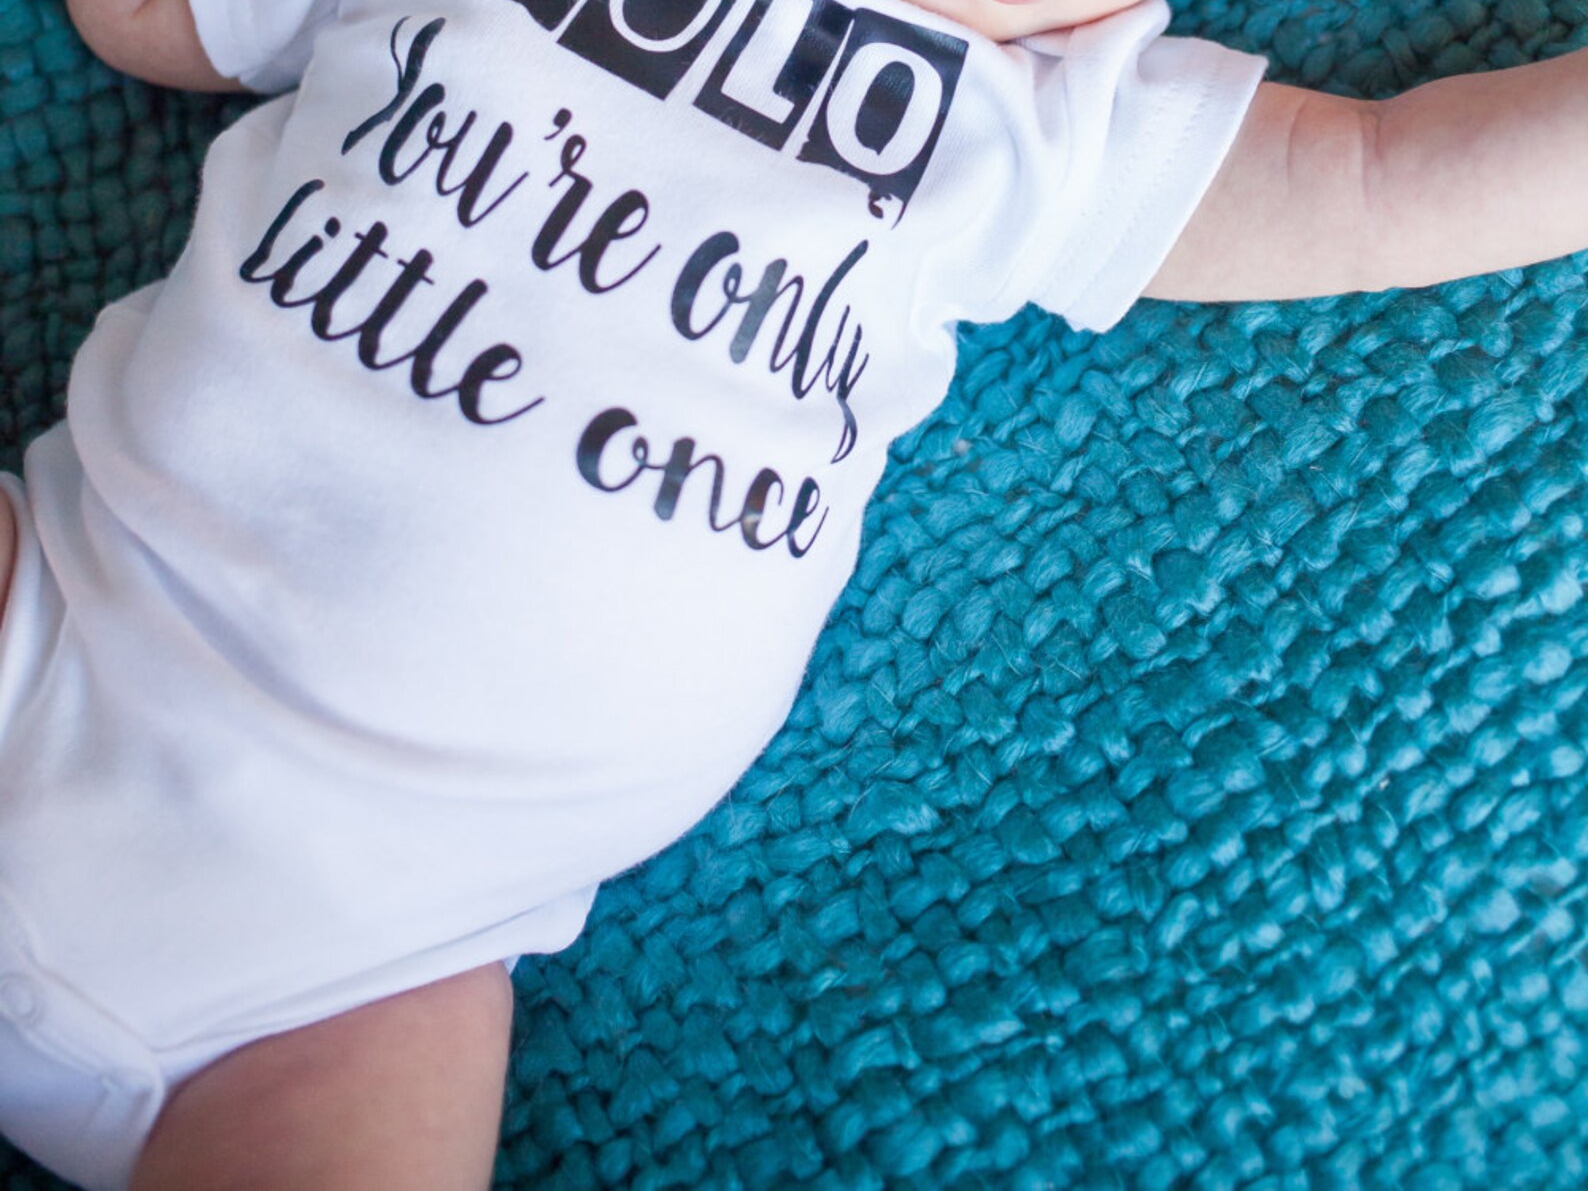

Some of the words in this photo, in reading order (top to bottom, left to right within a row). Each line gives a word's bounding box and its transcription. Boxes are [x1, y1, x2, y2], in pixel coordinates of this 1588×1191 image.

[239, 179, 546, 425] little
[575, 406, 830, 559] once
[341, 15, 662, 294] You're
[670, 239, 870, 465] only
